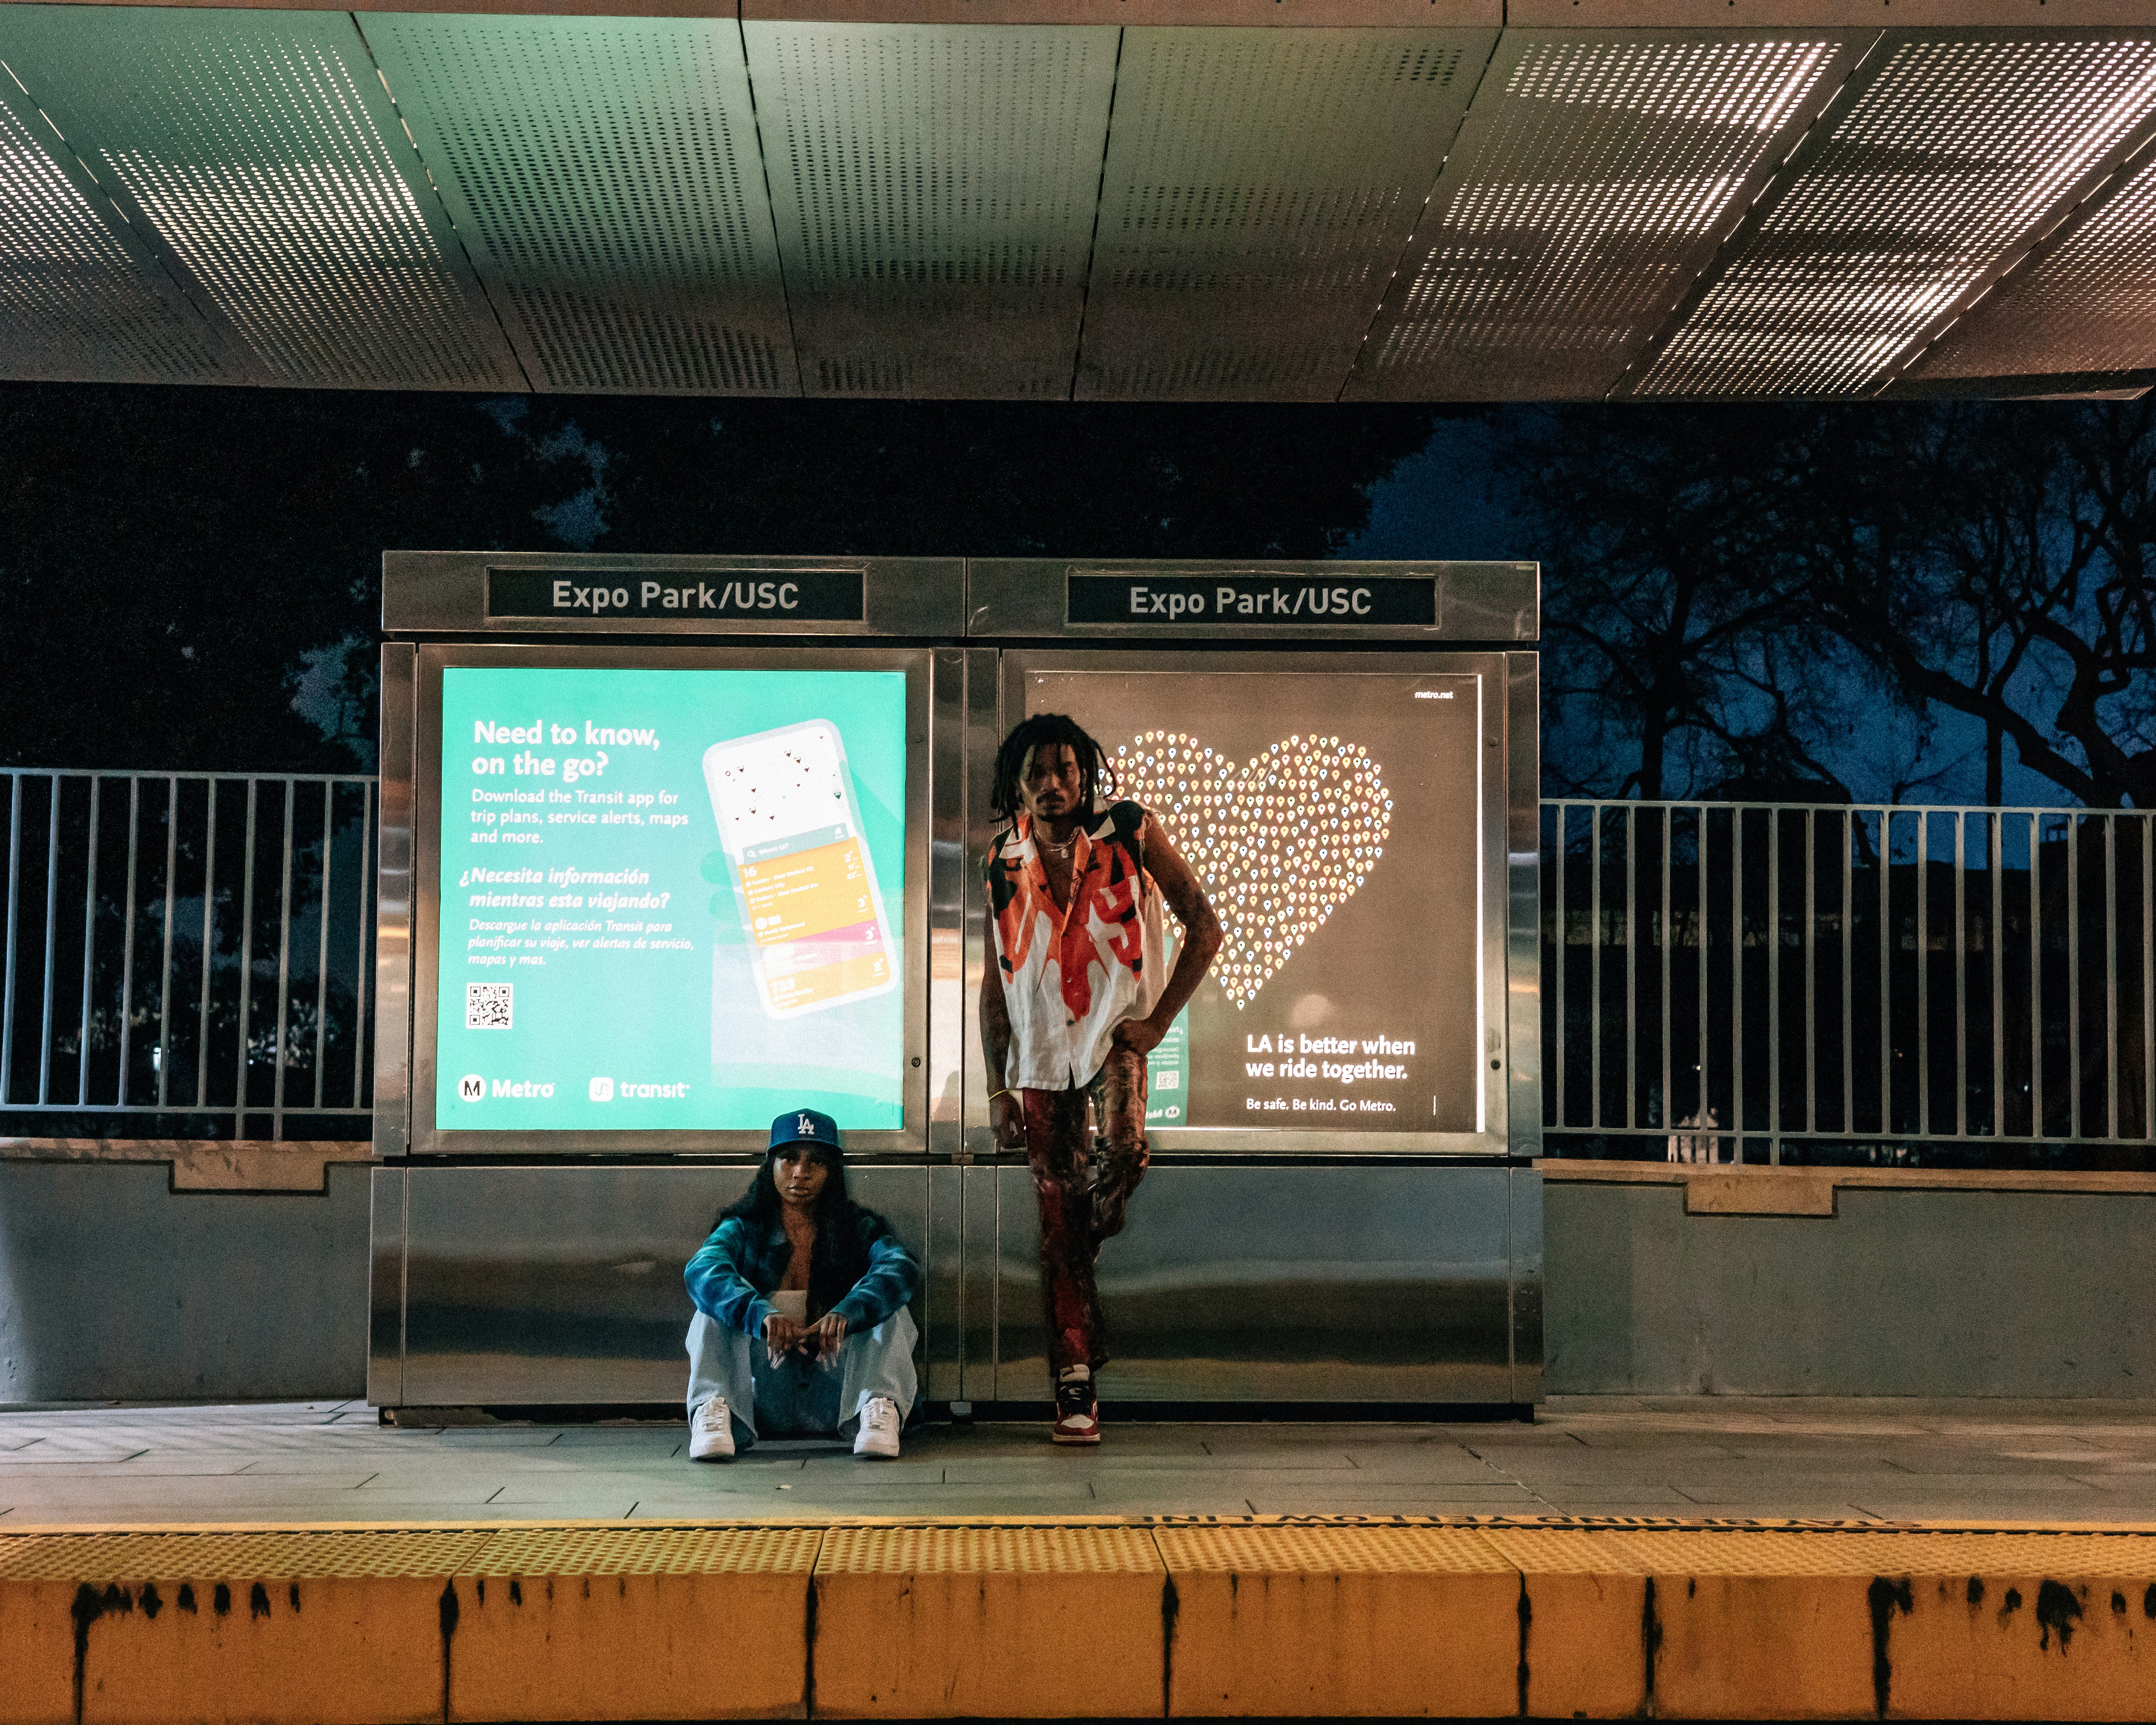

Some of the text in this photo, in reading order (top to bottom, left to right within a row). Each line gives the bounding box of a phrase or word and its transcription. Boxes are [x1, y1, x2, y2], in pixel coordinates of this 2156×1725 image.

[554, 581, 798, 613] Expo Park/USC
[1131, 587, 1371, 619] Expo Park/USC
[475, 720, 660, 750] Need to know,
[472, 750, 608, 783] on the go?
[472, 789, 678, 807] Download the Transit app for
[471, 809, 688, 828] trip plans, service alerts, maps
[470, 829, 543, 844] and more.
[459, 867, 649, 888] ¿Necesita información
[742, 866, 757, 878] 16
[469, 891, 670, 913] mientras esta viajando?
[469, 919, 672, 935] Descargue la aplicación Transit para
[468, 935, 522, 951] planificar
[524, 940, 537, 948] su
[541, 936, 568, 951] viaje,
[593, 936, 630, 948] alertas
[633, 937, 647, 949] de
[650, 938, 694, 950] servicio,
[468, 956, 546, 967] mapas y mas.
[1247, 1033, 1415, 1055] LA is better when
[1246, 1058, 1408, 1084] we ride together.
[492, 1079, 555, 1098] Metro
[620, 1082, 690, 1097] transit
[1247, 1098, 1396, 1111] Be safe. Be kind. Go Metro.
[798, 1114, 814, 1134] LA
[1536, 1516, 1761, 1526] BEHIND
